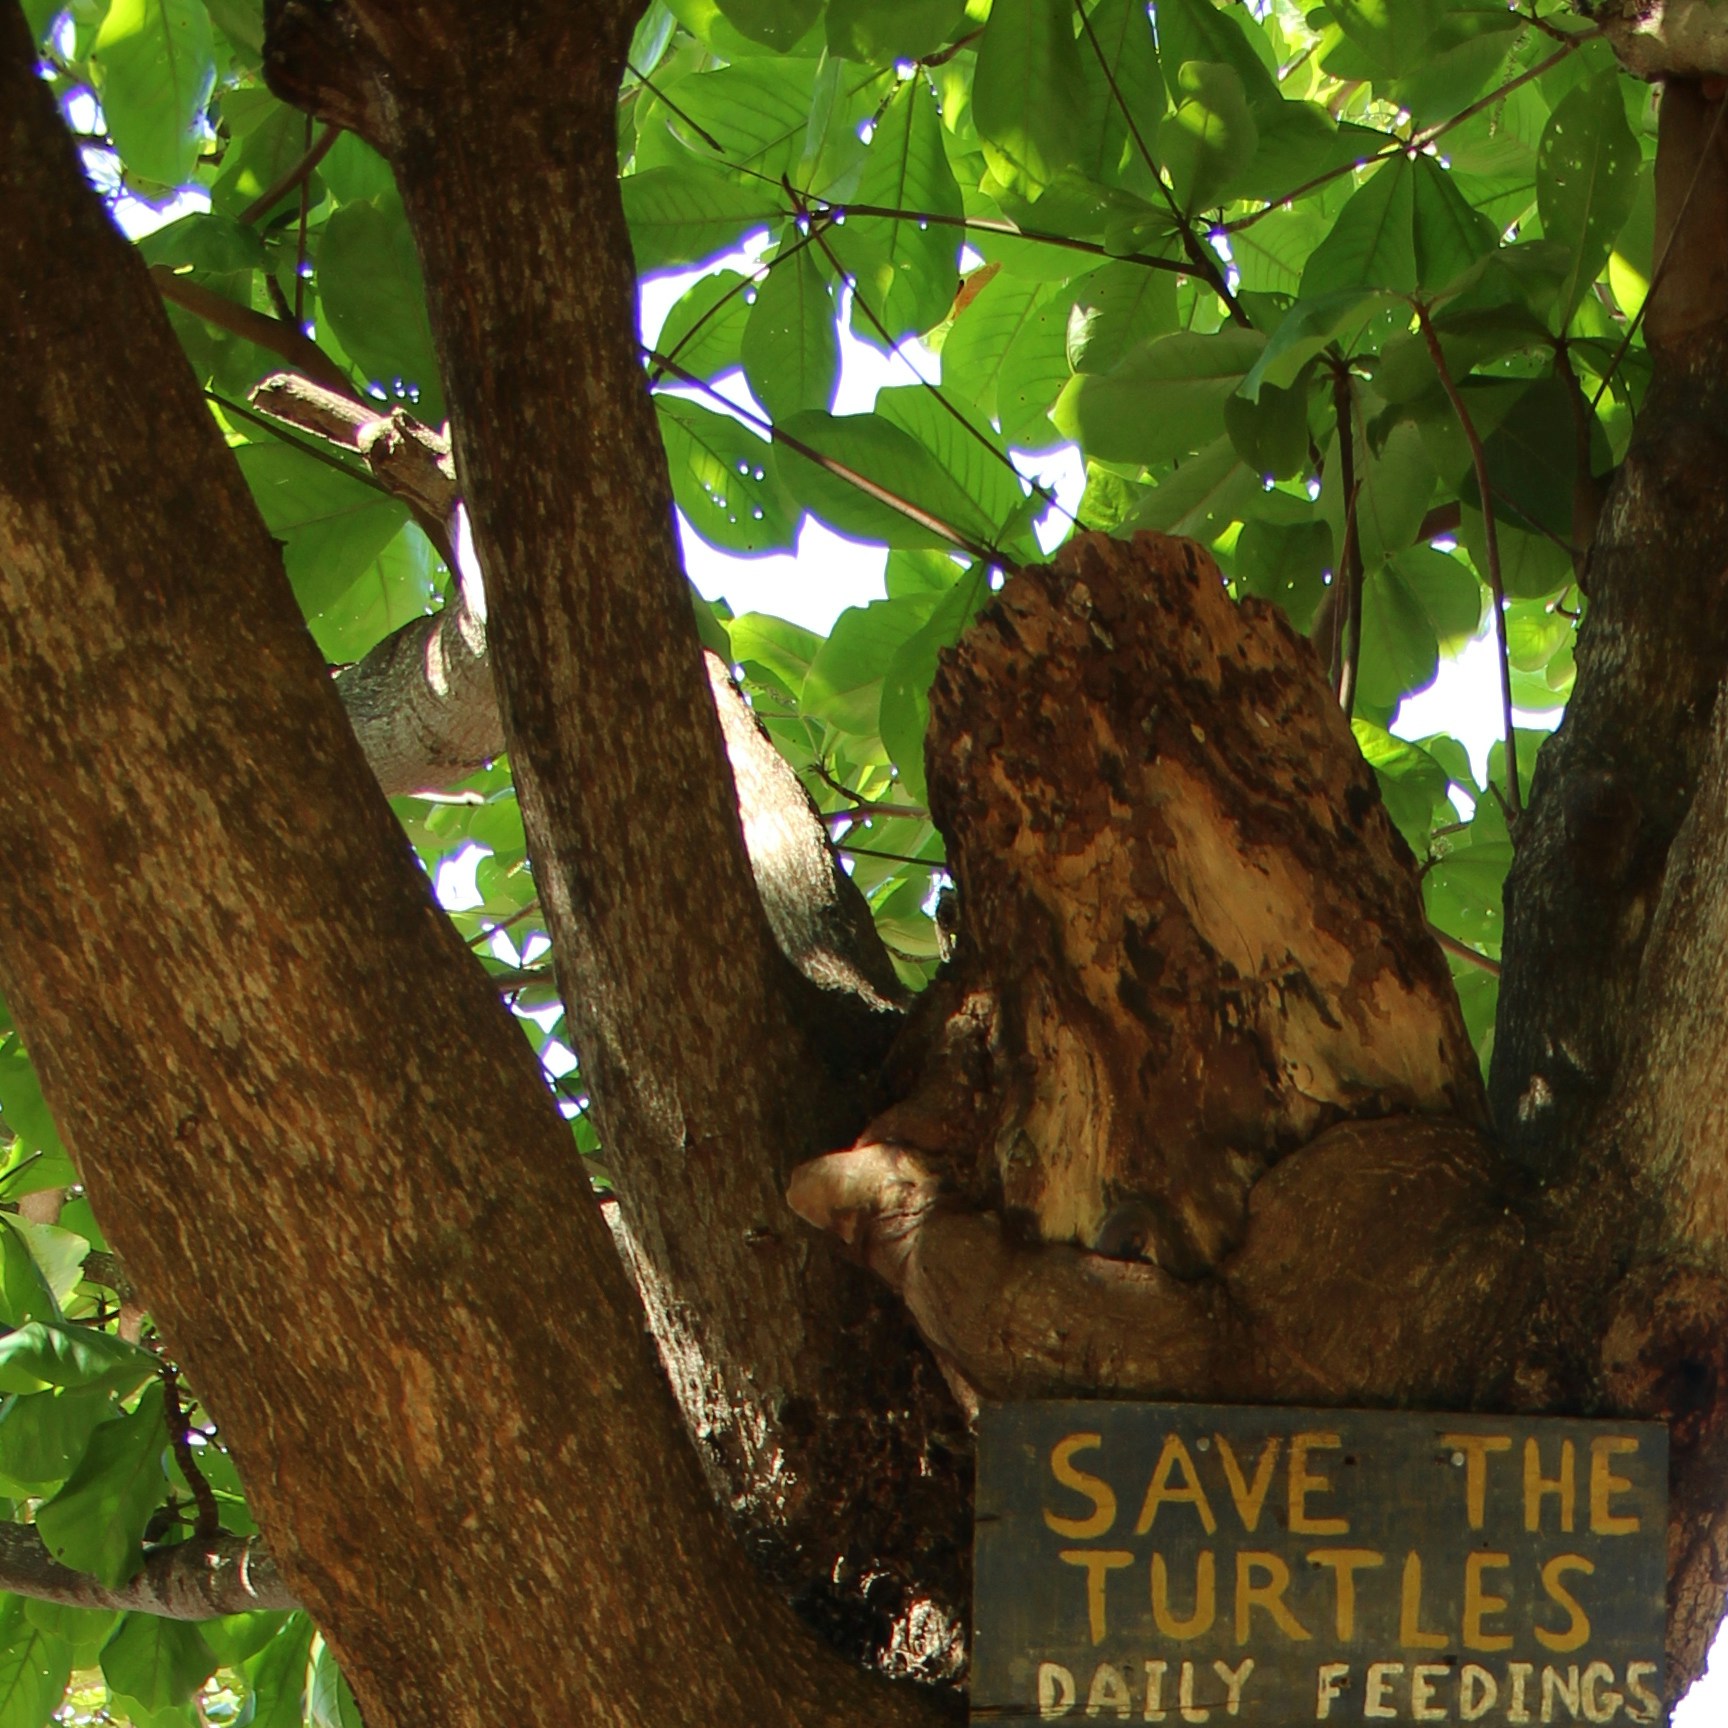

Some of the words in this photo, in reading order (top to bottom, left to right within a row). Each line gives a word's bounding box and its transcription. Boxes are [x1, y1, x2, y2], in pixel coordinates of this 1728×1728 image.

[1043, 1431, 1350, 1540] SAVE
[1440, 1434, 1641, 1535] THE
[1060, 1549, 1596, 1654] TURTLES
[1037, 1657, 1255, 1725] DAILY
[1316, 1661, 1661, 1727] FEEDINGS
